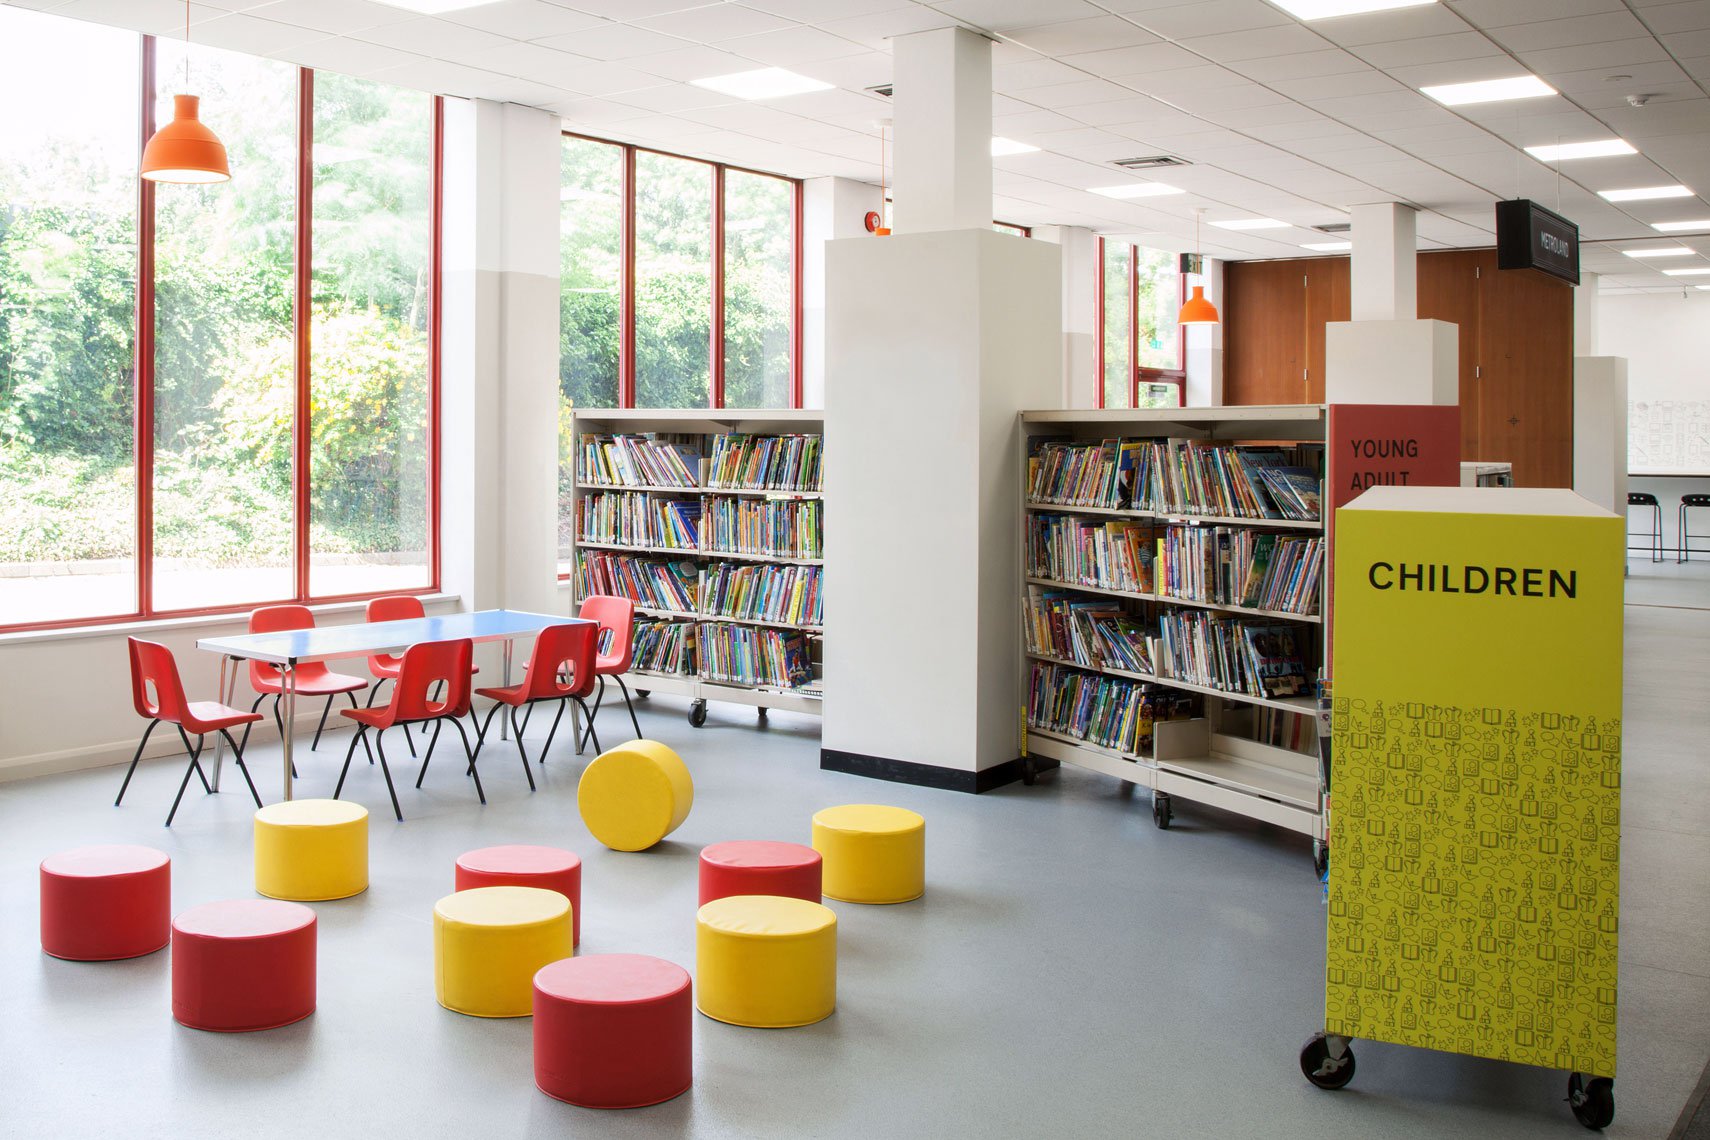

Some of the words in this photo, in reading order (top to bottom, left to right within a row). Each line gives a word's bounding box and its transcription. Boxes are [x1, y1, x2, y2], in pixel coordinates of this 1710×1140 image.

[1541, 231, 1569, 258] METROLAND
[1350, 439, 1418, 458] YOUNG
[1368, 561, 1576, 598] CHILDREN
